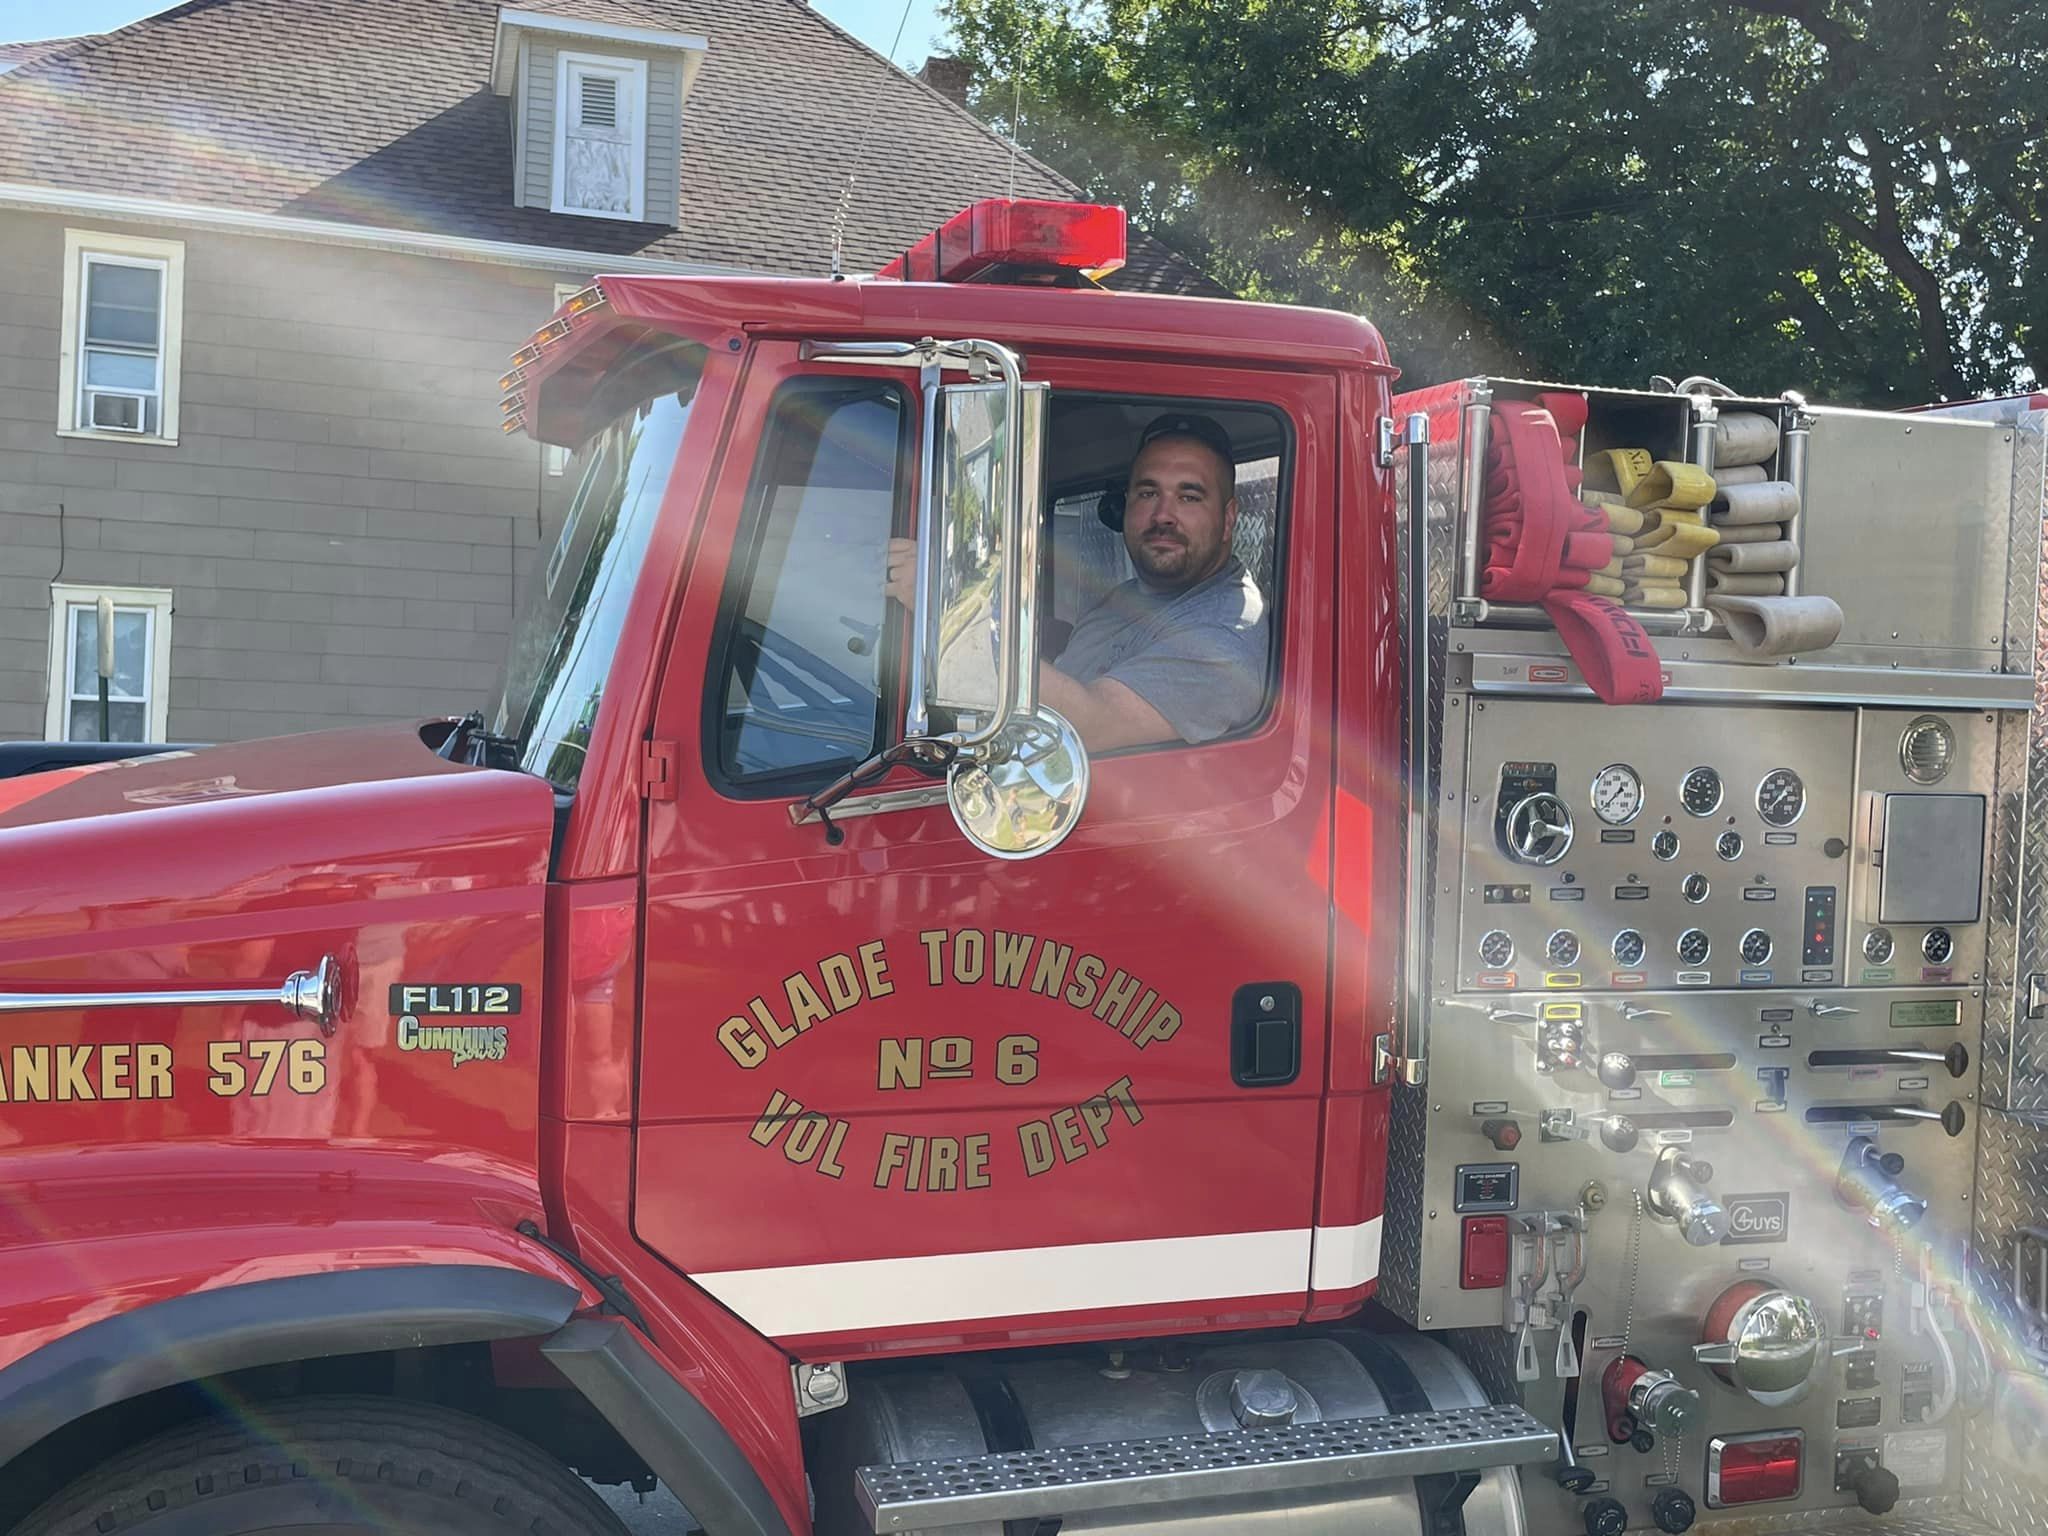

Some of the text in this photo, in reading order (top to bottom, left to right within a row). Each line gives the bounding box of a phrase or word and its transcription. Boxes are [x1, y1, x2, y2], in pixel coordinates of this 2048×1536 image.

[403, 986, 509, 1012] FL112
[716, 928, 1183, 1070] GLADE TOWNSHIP
[0, 1039, 327, 1103] NKER 576
[995, 1034, 1040, 1085] 6
[748, 1075, 1145, 1192] VOL FIRE DEPT
